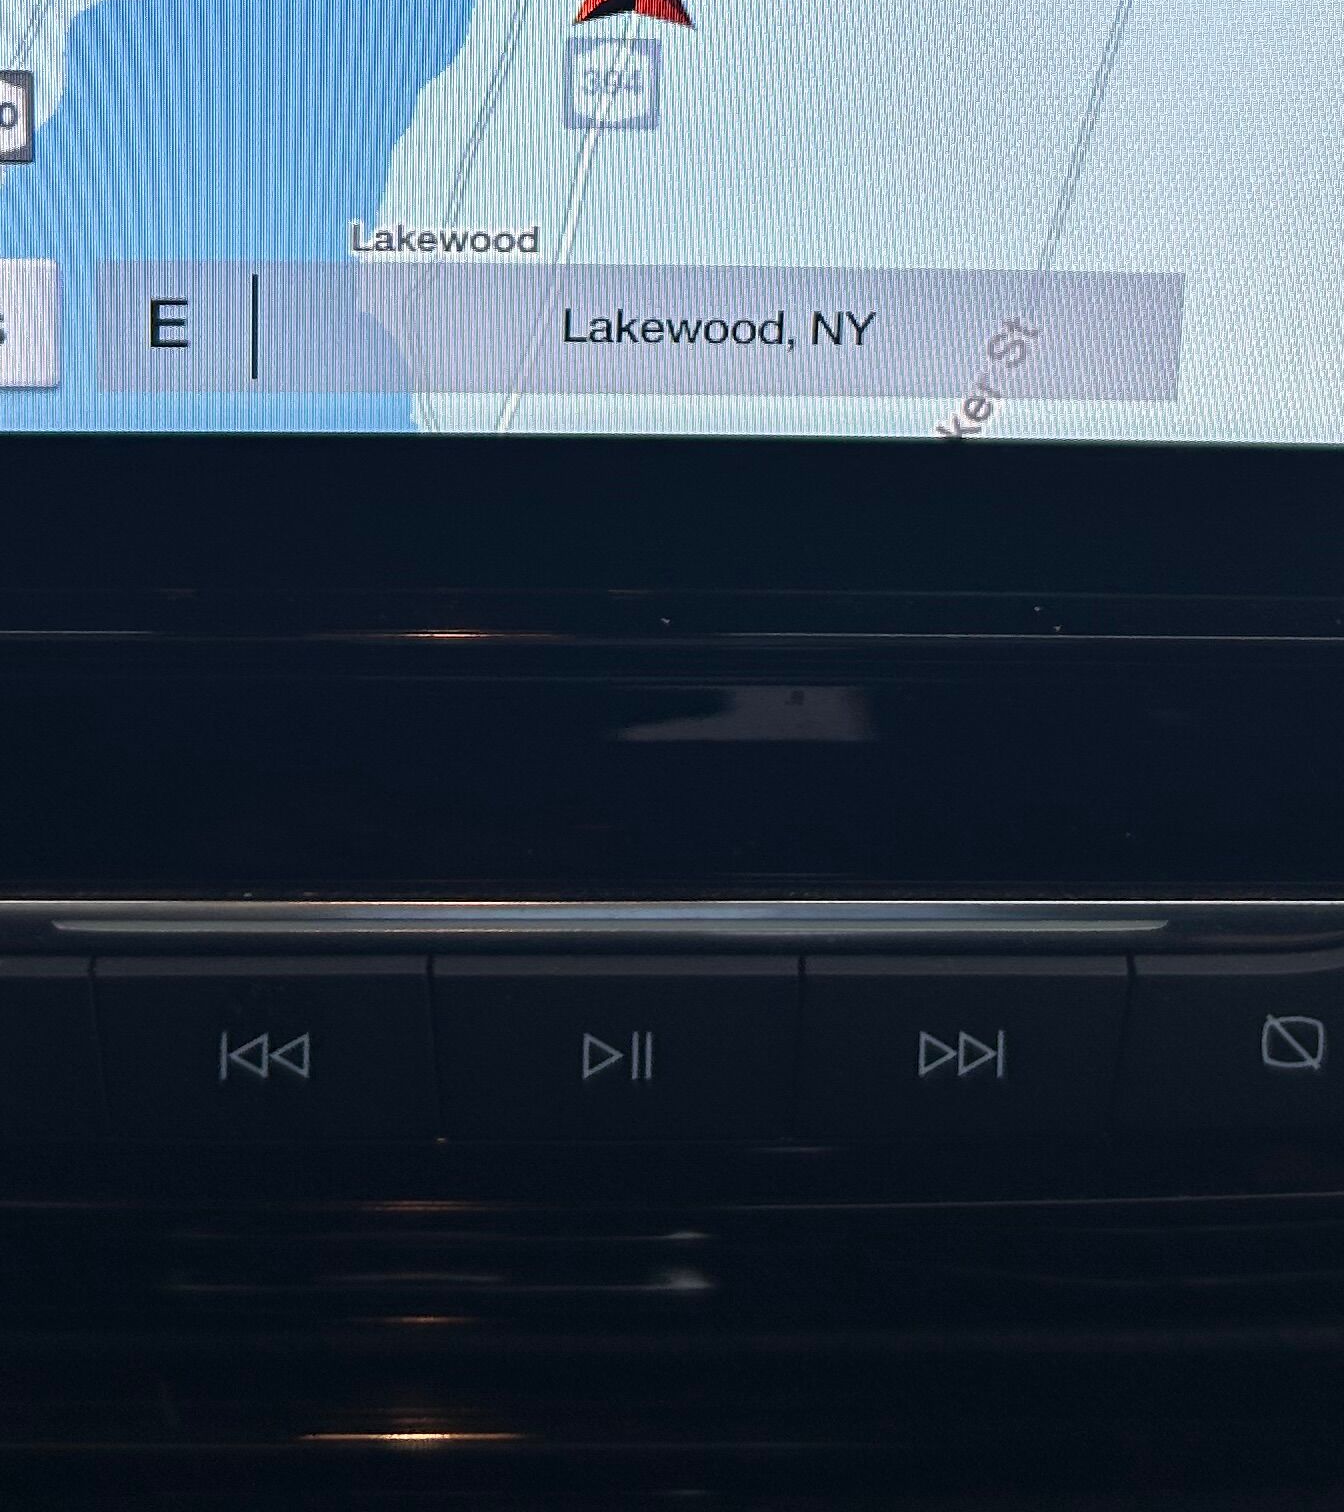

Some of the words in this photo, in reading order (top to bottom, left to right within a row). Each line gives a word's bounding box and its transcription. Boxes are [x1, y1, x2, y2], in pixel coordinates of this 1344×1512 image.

[350, 223, 539, 255] Lakewood
[151, 299, 189, 350] E
[563, 308, 796, 353] Lakewood,
[811, 312, 877, 347] NY
[988, 317, 1038, 369] St
